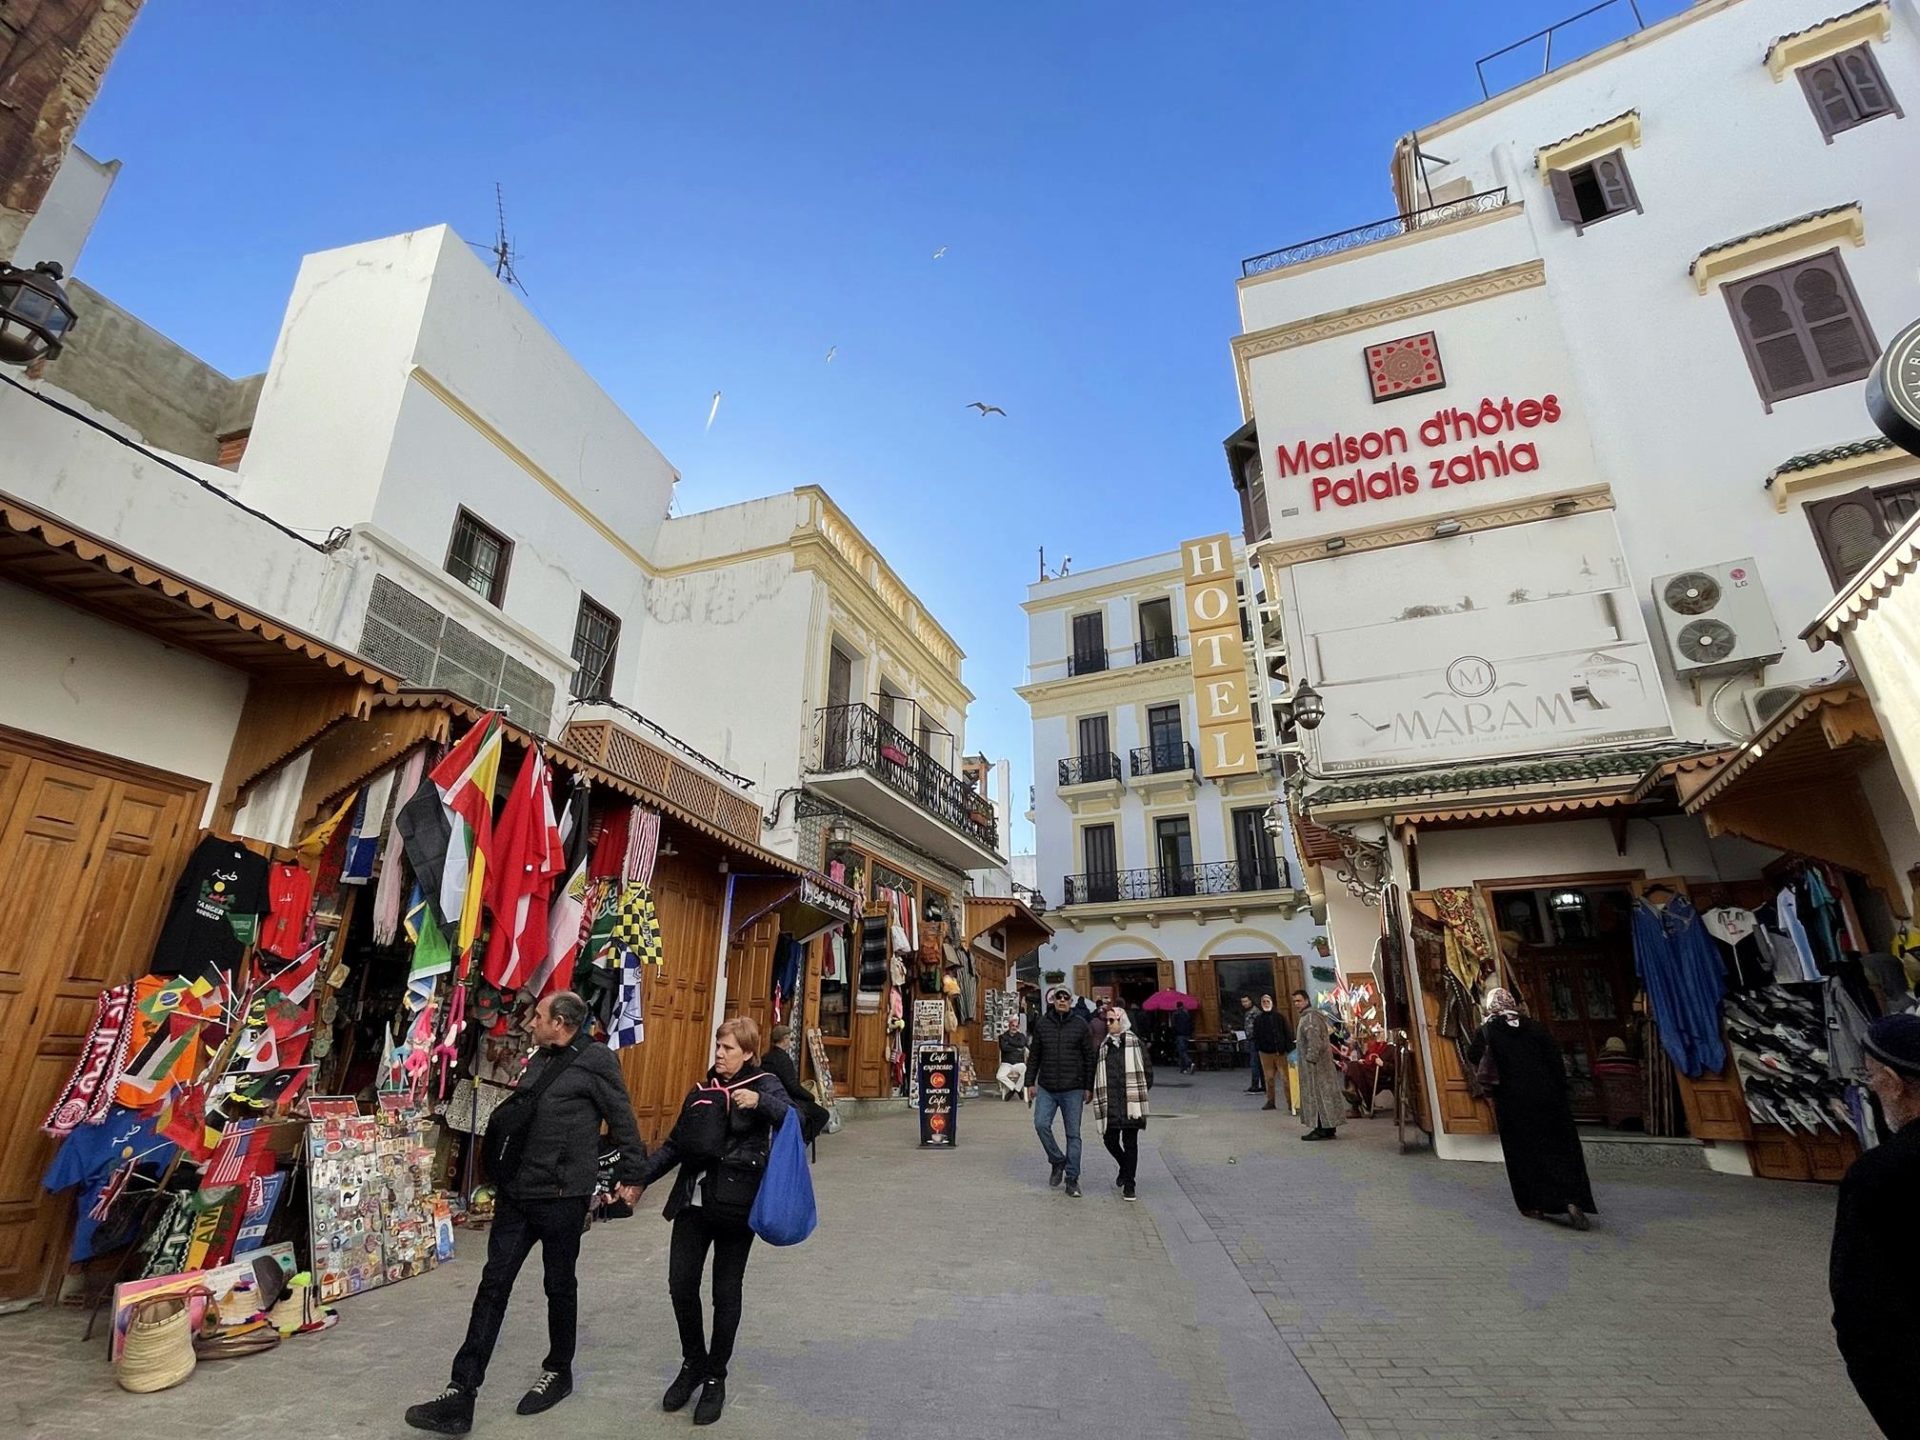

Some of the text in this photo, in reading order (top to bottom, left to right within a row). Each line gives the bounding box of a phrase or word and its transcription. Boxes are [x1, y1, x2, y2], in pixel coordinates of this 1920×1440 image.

[1278, 394, 1562, 478] Maison d'hôtes
[1312, 440, 1540, 512] Palais zahia
[1735, 580, 1748, 588] LG
[1189, 539, 1245, 769] HOTEL
[1458, 666, 1484, 687] M
[1394, 692, 1577, 744] MARAM
[930, 1052, 948, 1063] Café
[928, 1095, 947, 1106] Café
